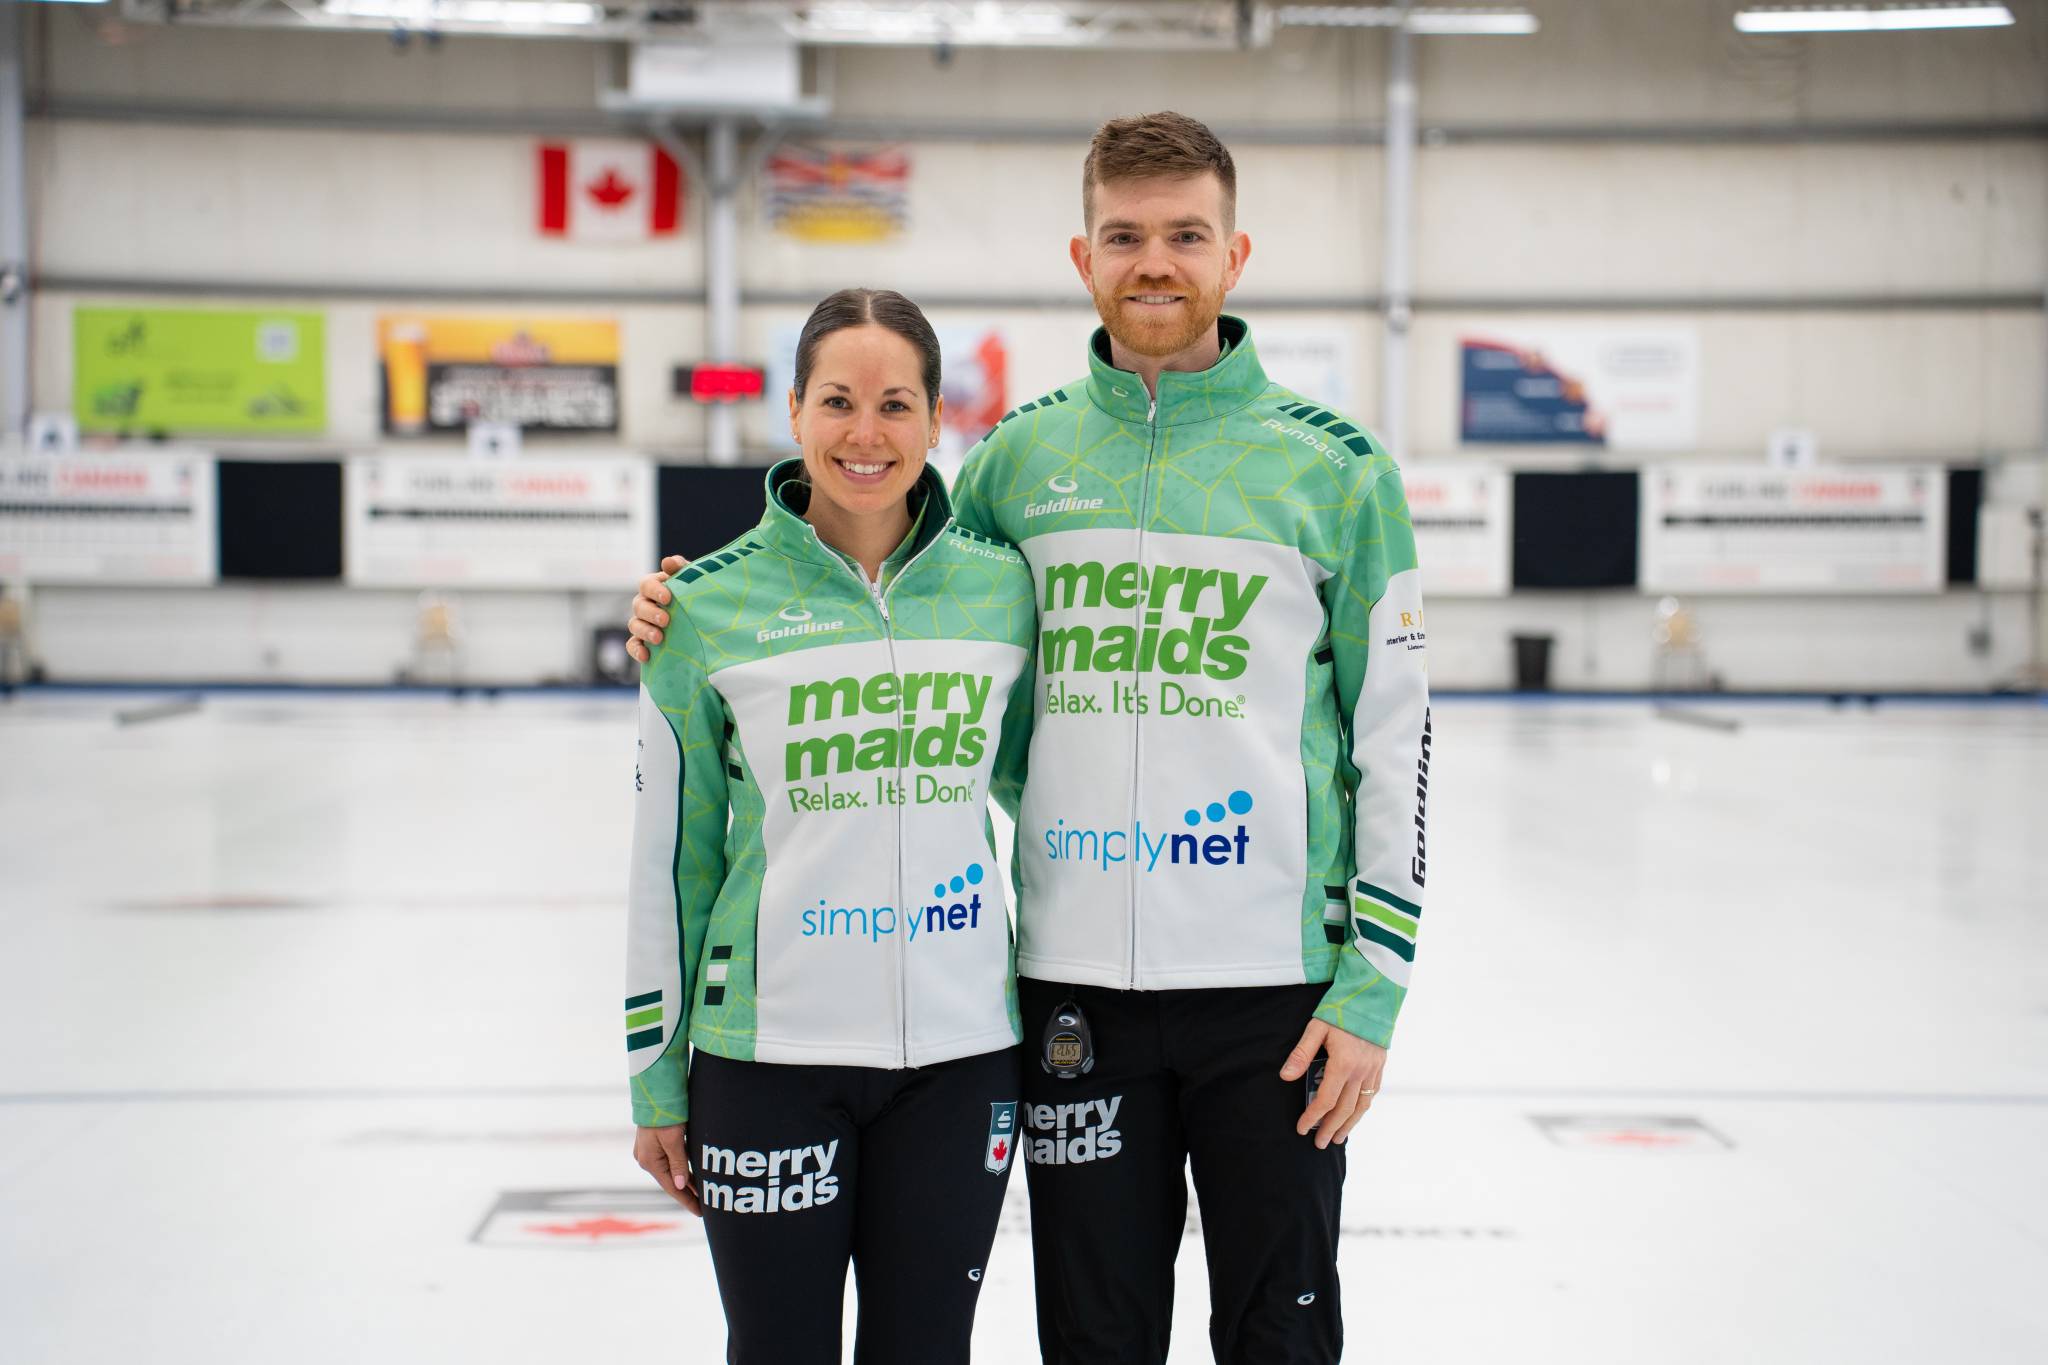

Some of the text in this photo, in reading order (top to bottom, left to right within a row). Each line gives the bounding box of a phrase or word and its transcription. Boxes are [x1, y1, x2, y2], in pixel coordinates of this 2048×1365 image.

[1261, 418, 1348, 470] Runback
[1023, 496, 1104, 519] Goldline
[1044, 561, 1270, 632] merry
[756, 620, 844, 644] Goldline
[1041, 616, 1250, 681] maids
[788, 672, 993, 726] merry
[785, 712, 987, 782] maids
[788, 782, 868, 814] Relax.
[802, 893, 981, 943] simpynet
[702, 1138, 839, 1181] merry
[702, 1172, 839, 1214] maids
